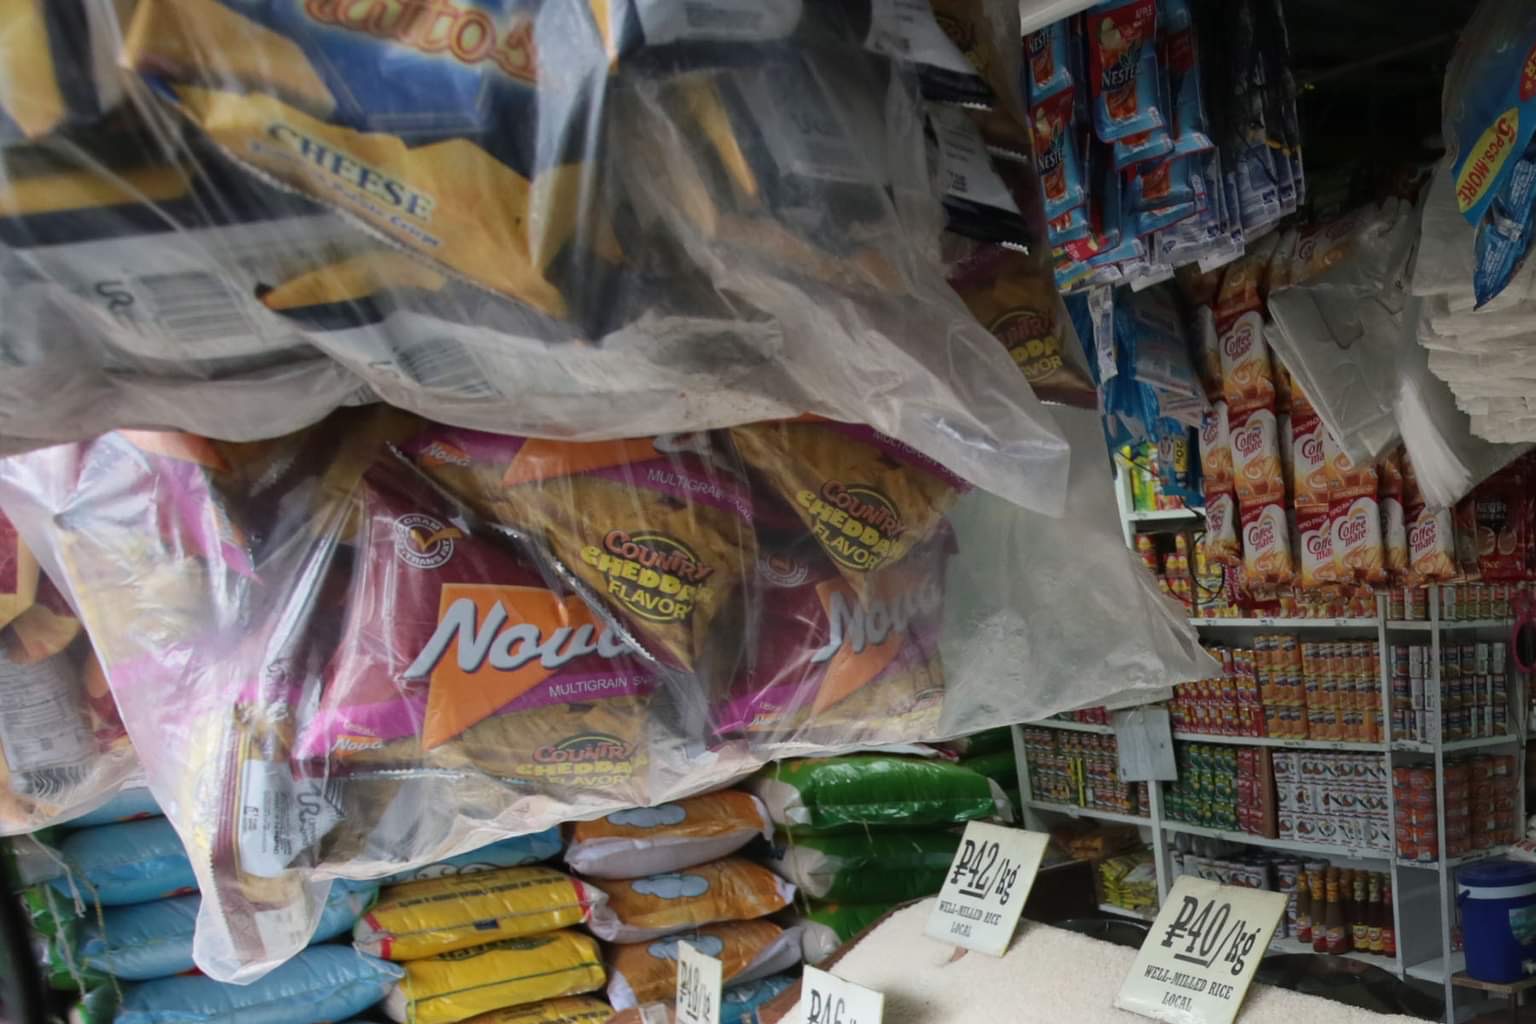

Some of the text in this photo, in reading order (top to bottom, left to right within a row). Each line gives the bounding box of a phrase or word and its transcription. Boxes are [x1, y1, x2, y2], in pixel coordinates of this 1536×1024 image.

[1496, 117, 1517, 144] 5
[266, 119, 435, 223] CHEESE
[1235, 427, 1263, 452] Coffee
[1301, 437, 1324, 460] Coff
[1249, 522, 1274, 546] Coffee
[1337, 517, 1368, 541] Coffee
[1344, 528, 1368, 548] mate
[1409, 523, 1438, 548] Coffee
[602, 530, 714, 582] COUNTRY
[814, 521, 881, 569] FLAVOR
[1414, 534, 1438, 553] mate
[608, 580, 693, 620] FLAVOR
[549, 675, 628, 698] MULTIGRAIN
[332, 736, 383, 753] Nova
[532, 741, 639, 764] COUNTRY
[950, 839, 1022, 906] ₱42/kg
[1160, 896, 1262, 976] ₱40/kg
[1143, 963, 1235, 1001] WELL-MILLED RICE
[1160, 991, 1193, 1012] LOCAL
